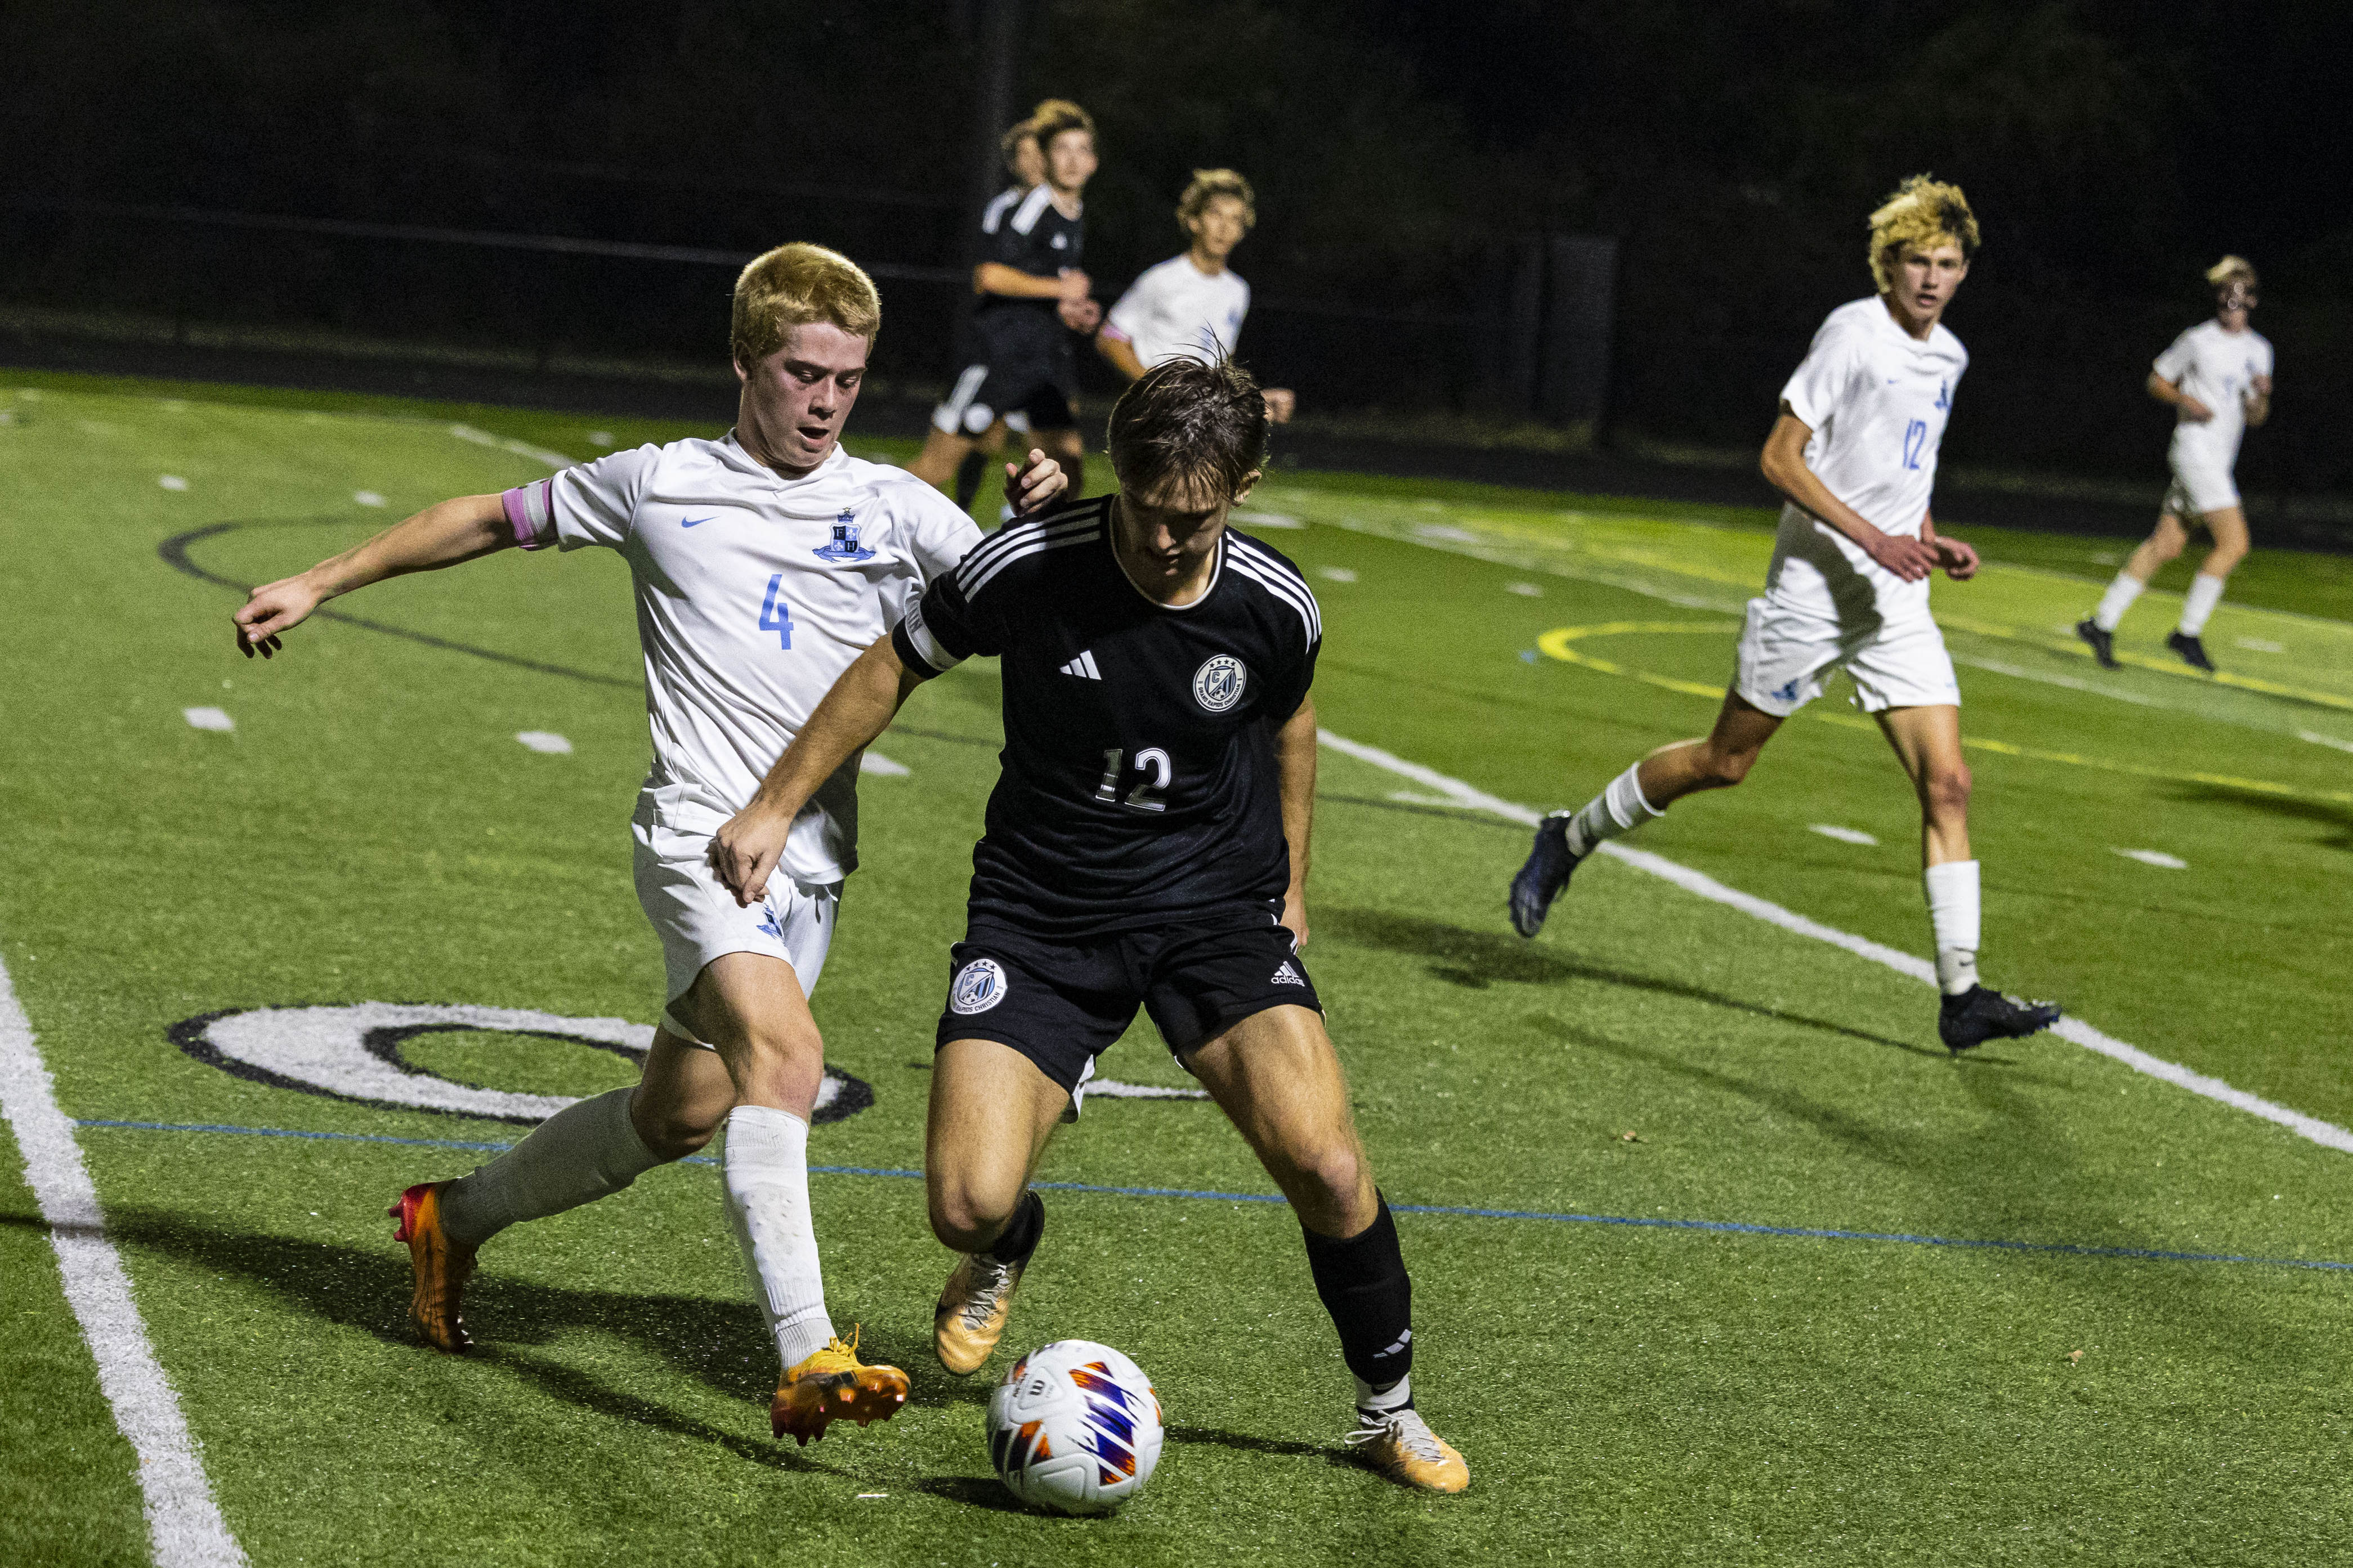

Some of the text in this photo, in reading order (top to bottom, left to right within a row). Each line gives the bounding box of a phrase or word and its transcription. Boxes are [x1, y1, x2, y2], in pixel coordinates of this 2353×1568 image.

[1903, 418, 1926, 470] 12
[836, 528, 843, 537] F
[847, 542, 855, 550] H
[759, 574, 794, 650] 4
[1212, 671, 1220, 683] C
[1224, 684, 1241, 705] CHRISTIAN
[1095, 747, 1171, 812] 12
[964, 974, 974, 986] C
[974, 991, 1000, 1011] CHRISTIAN
